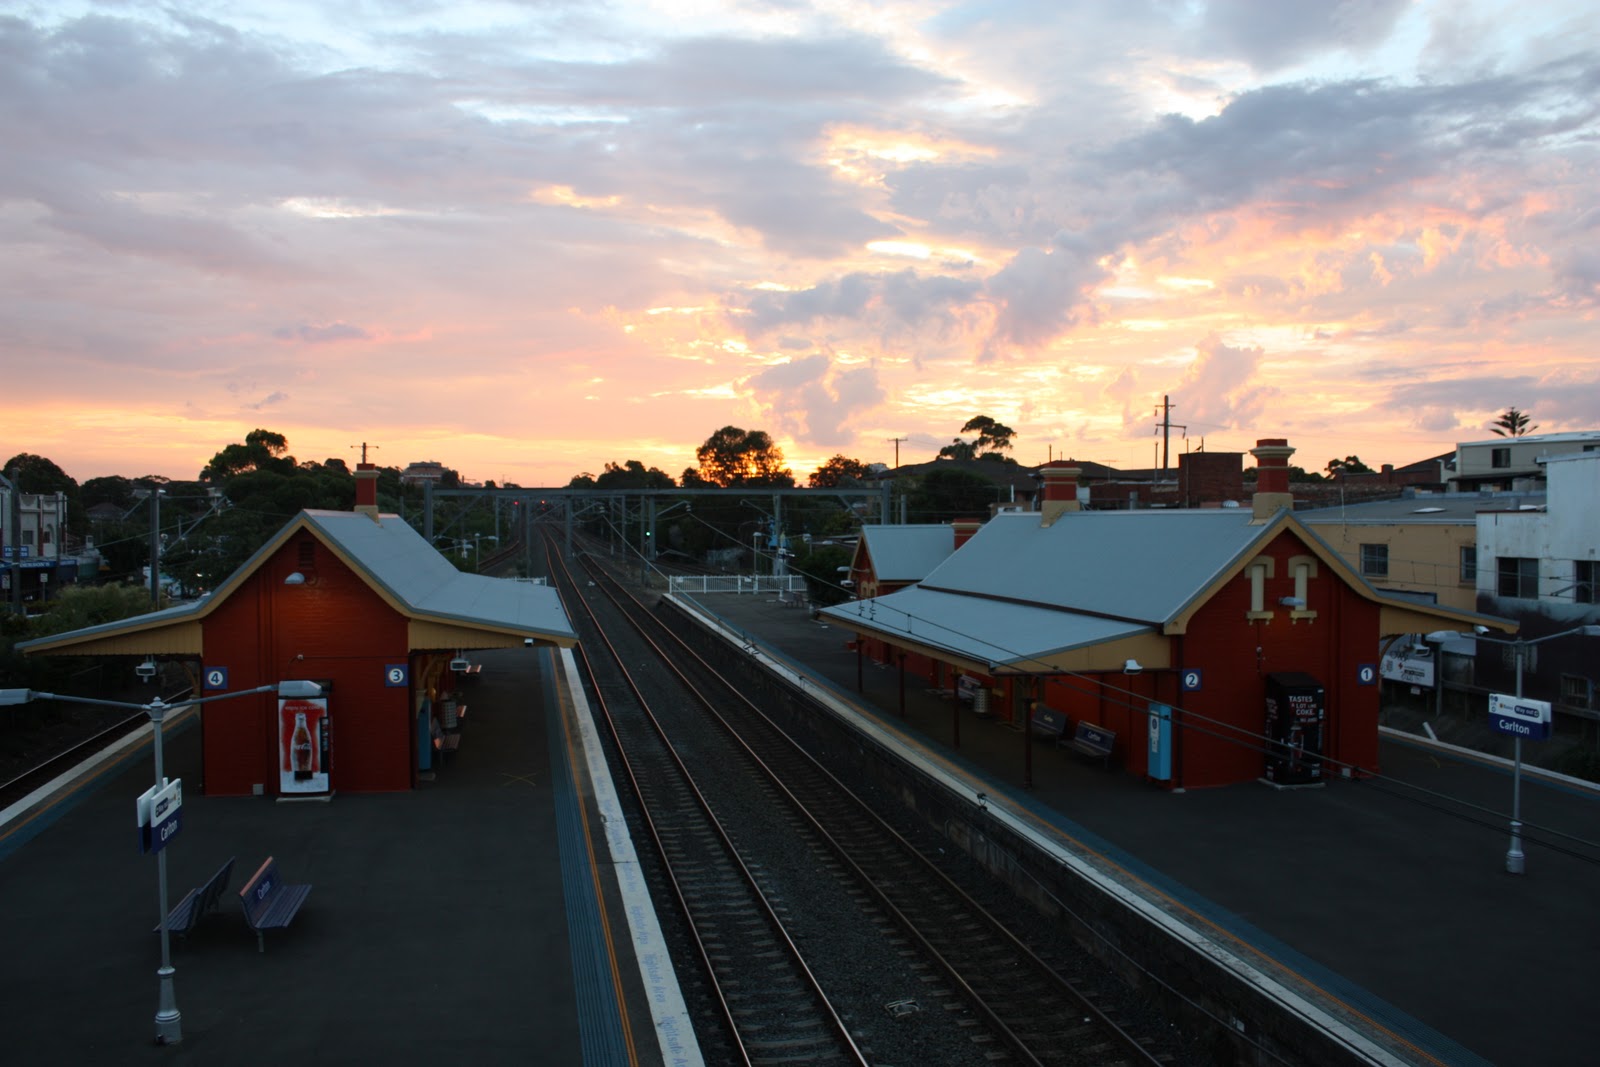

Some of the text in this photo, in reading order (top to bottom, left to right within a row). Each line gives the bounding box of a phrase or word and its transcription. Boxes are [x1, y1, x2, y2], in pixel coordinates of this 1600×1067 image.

[211, 672, 220, 684] 4
[393, 670, 400, 681] 3
[1189, 674, 1195, 686] 2
[1364, 669, 1369, 680] 1
[1515, 706, 1525, 714] Way
[1499, 719, 1530, 735] Carlton
[161, 819, 178, 841] Carlton
[660, 1015, 684, 1055] Nightsafe
